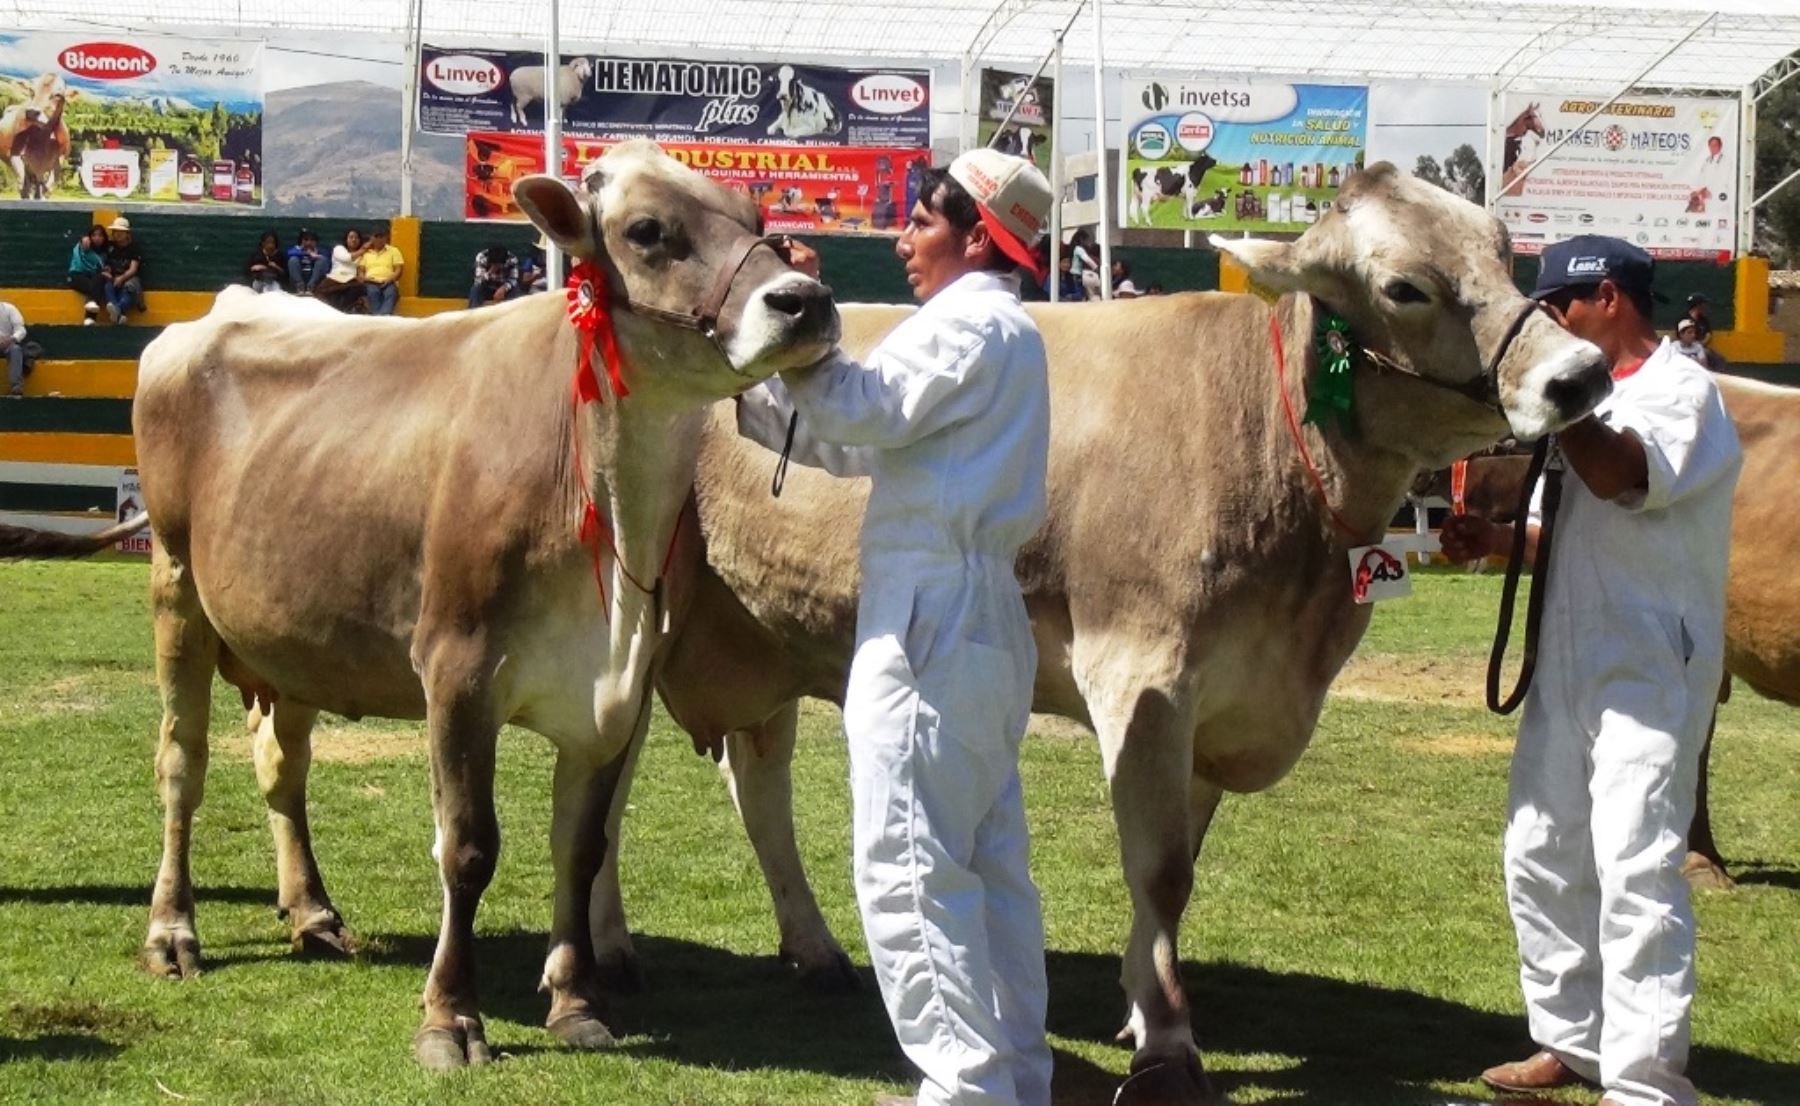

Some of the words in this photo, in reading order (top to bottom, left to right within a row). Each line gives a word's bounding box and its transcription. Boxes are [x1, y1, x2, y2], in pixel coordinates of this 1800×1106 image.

[64, 52, 150, 72] Biomont
[434, 64, 496, 84] Linvet
[595, 60, 762, 98] HEMATOMIC
[860, 85, 920, 102] Linvet
[1180, 87, 1250, 107] invetsa
[694, 95, 760, 132] plus
[1305, 119, 1351, 132] SALUD
[1317, 134, 1361, 147] ANIMAL
[1630, 131, 1691, 150] MATEO'S
[769, 171, 859, 181] HERRAMIENTAS
